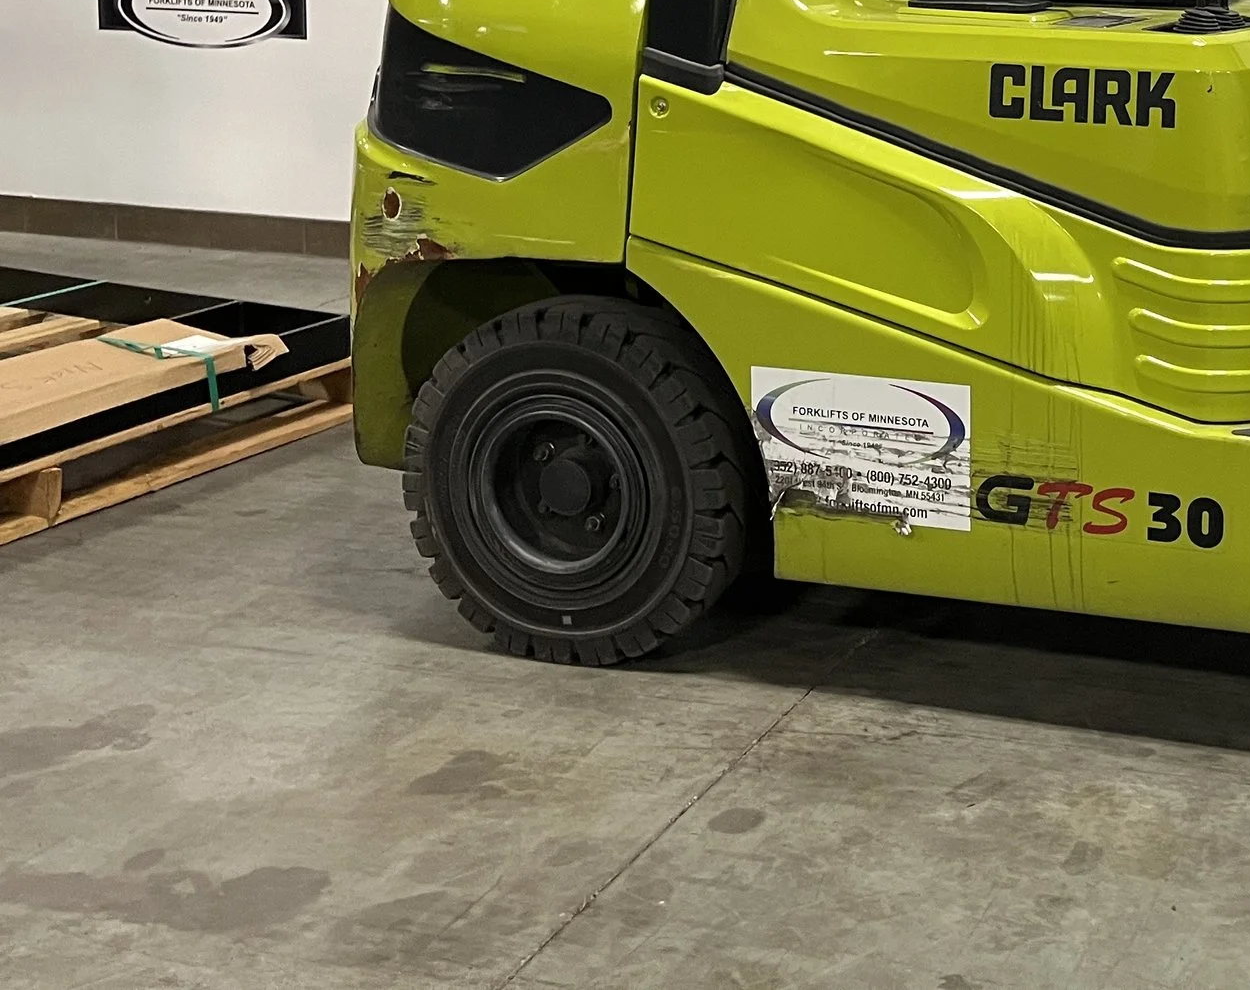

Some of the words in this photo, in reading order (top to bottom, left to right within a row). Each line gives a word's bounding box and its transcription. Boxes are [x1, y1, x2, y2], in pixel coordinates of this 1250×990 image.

[207, 0, 256, 9] MINNESOTA
[988, 63, 1176, 128] CLARK
[792, 406, 849, 420] FORKLIFTS
[851, 412, 865, 421] OF
[868, 414, 929, 428] MINNESOTA
[866, 469, 895, 486] (800)
[898, 473, 952, 490] 752-4300
[976, 475, 1136, 534] GTS
[1147, 491, 1224, 549] 30
